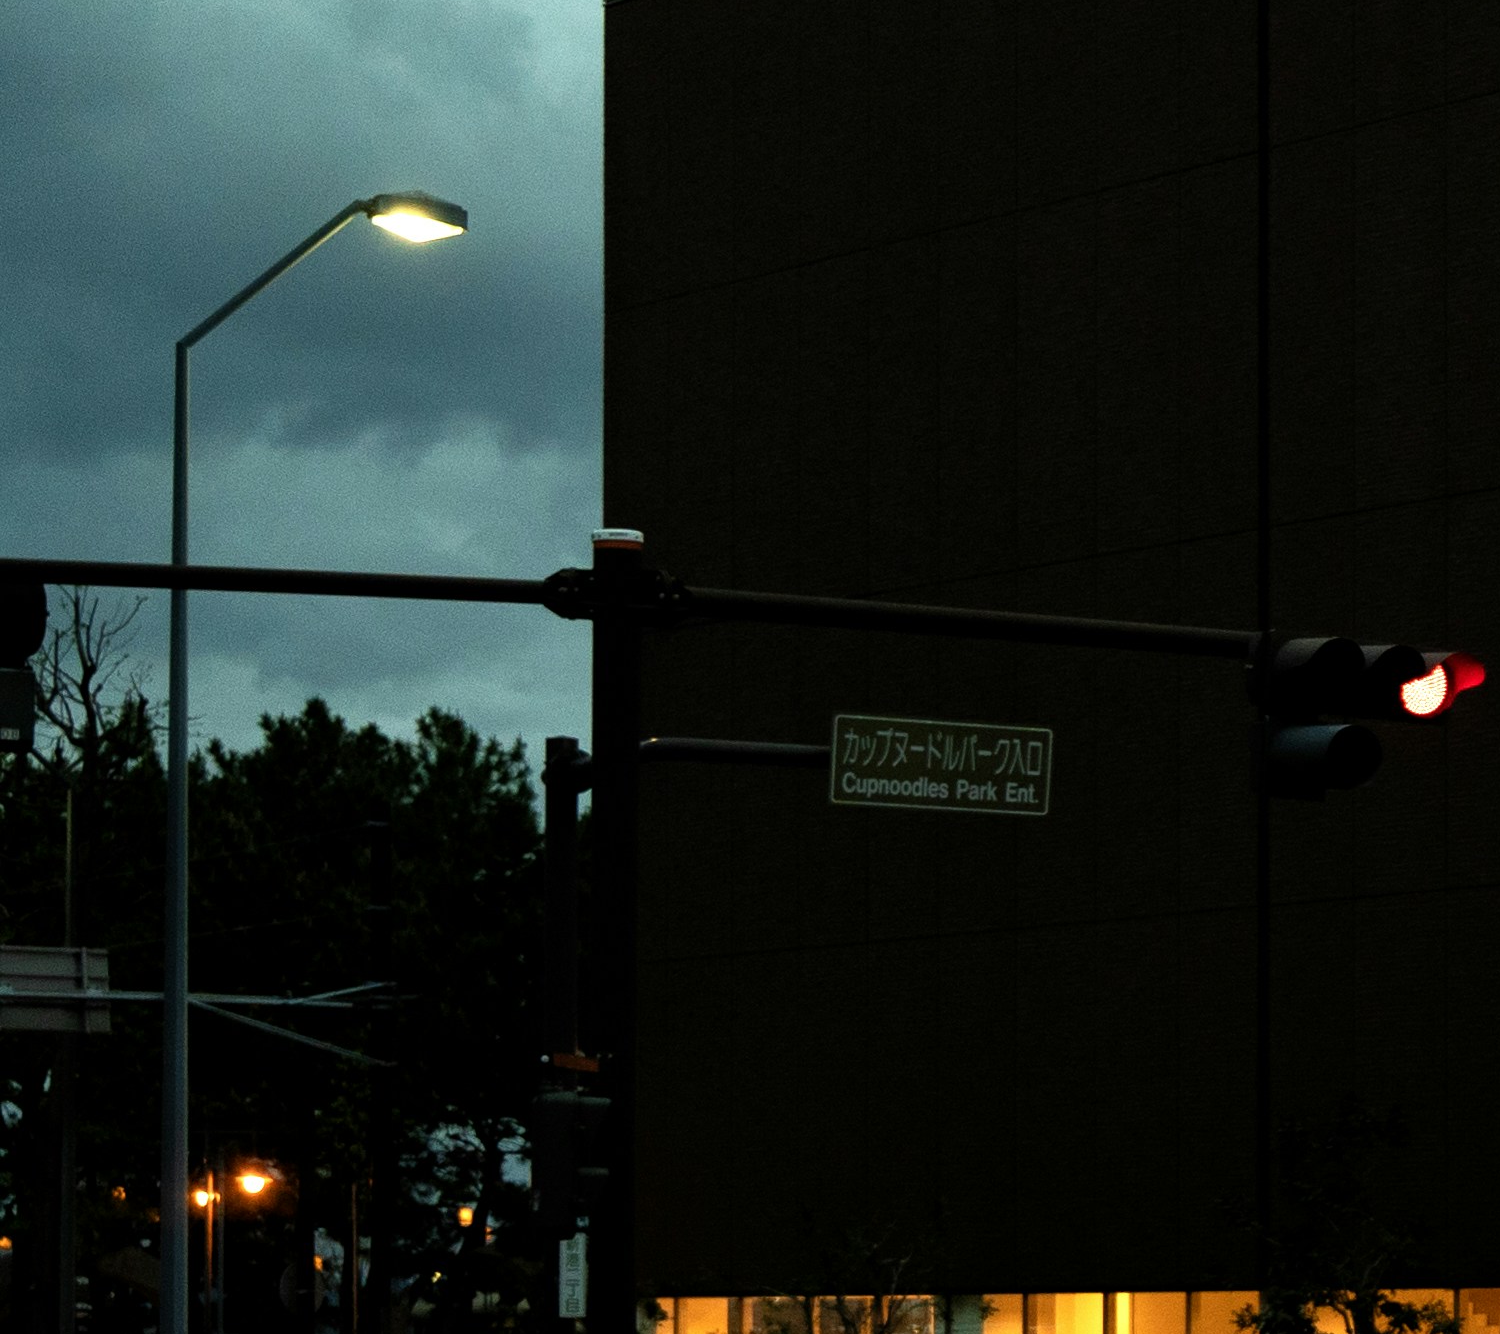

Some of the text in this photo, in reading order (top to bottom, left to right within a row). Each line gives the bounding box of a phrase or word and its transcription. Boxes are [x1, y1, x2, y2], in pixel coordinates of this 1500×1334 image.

[843, 727, 1044, 776] カップヌードルパーク入口
[842, 772, 1039, 804] Cupnoodles Park Ent.
